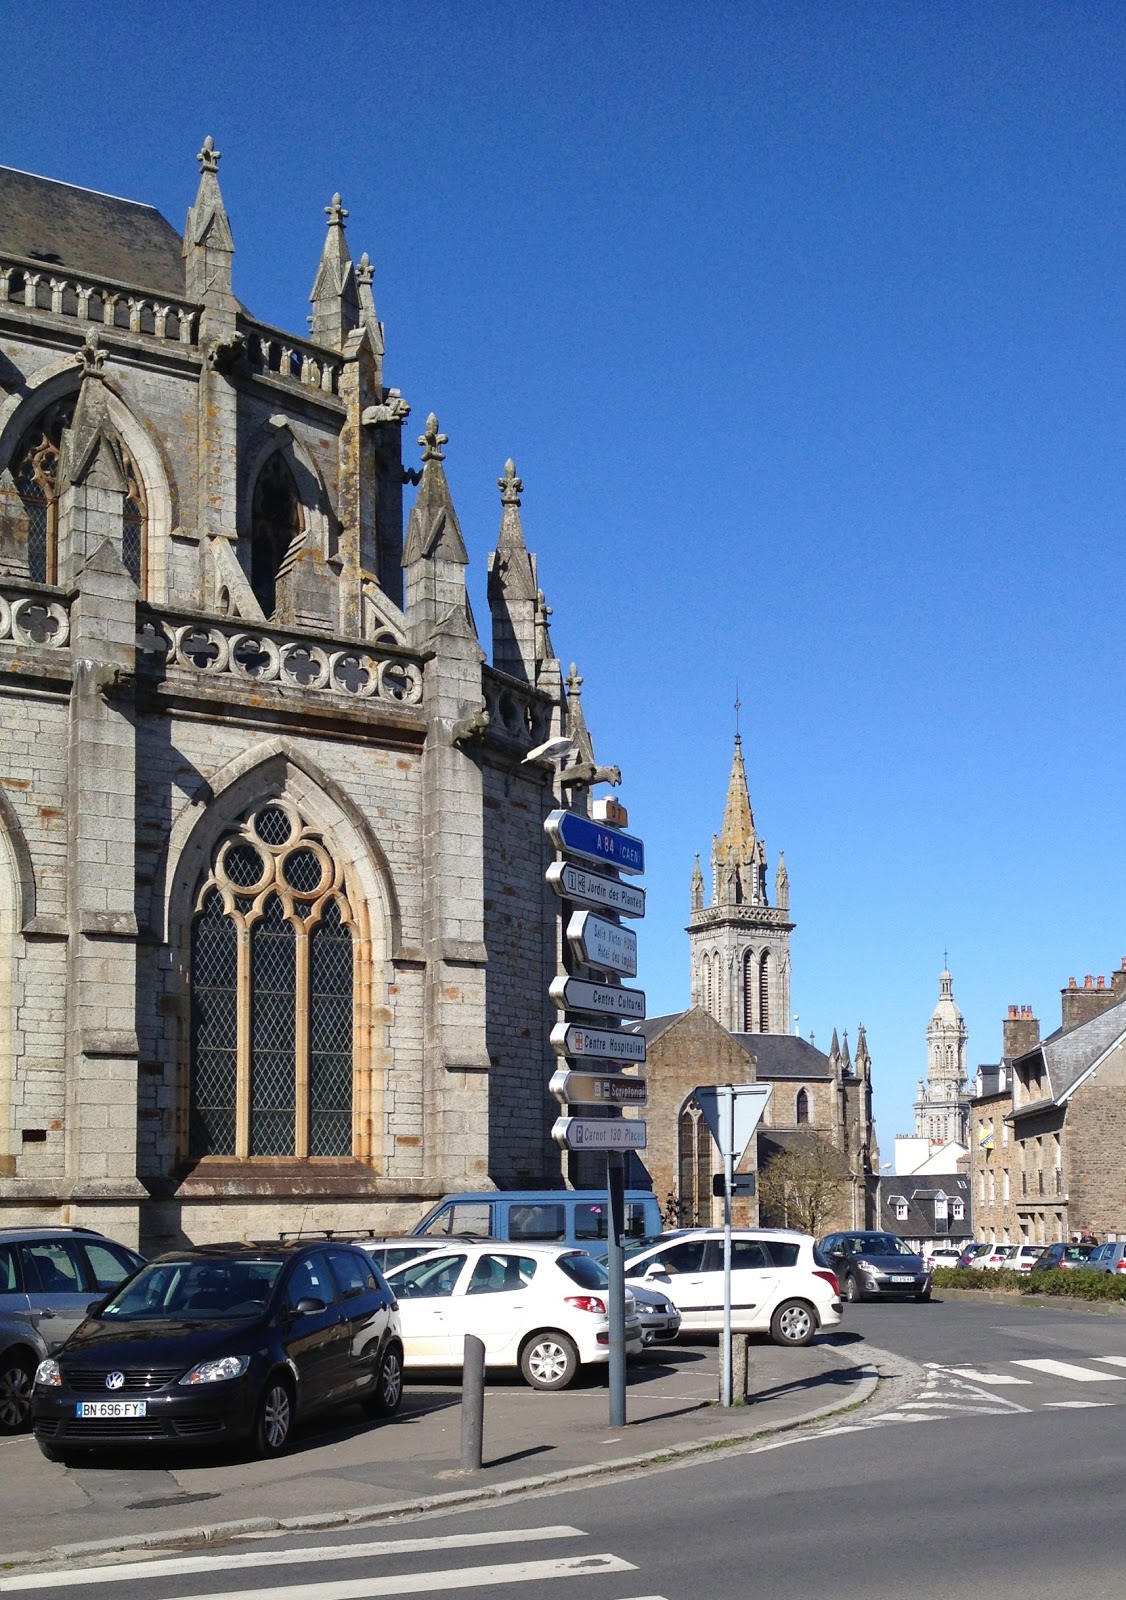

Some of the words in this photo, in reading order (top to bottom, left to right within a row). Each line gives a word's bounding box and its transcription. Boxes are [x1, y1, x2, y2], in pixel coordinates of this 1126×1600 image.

[596, 833, 602, 850] A
[603, 835, 614, 854] 84
[587, 880, 607, 897] Jardin
[608, 887, 619, 901] des
[621, 890, 642, 909] Plantes
[593, 990, 614, 1006] Centre
[618, 994, 643, 1011] Culturel
[584, 1035, 606, 1050] Centre
[609, 1037, 644, 1055] Hospitalier
[584, 1127, 606, 1142] Carnot
[610, 1128, 621, 1142] 130
